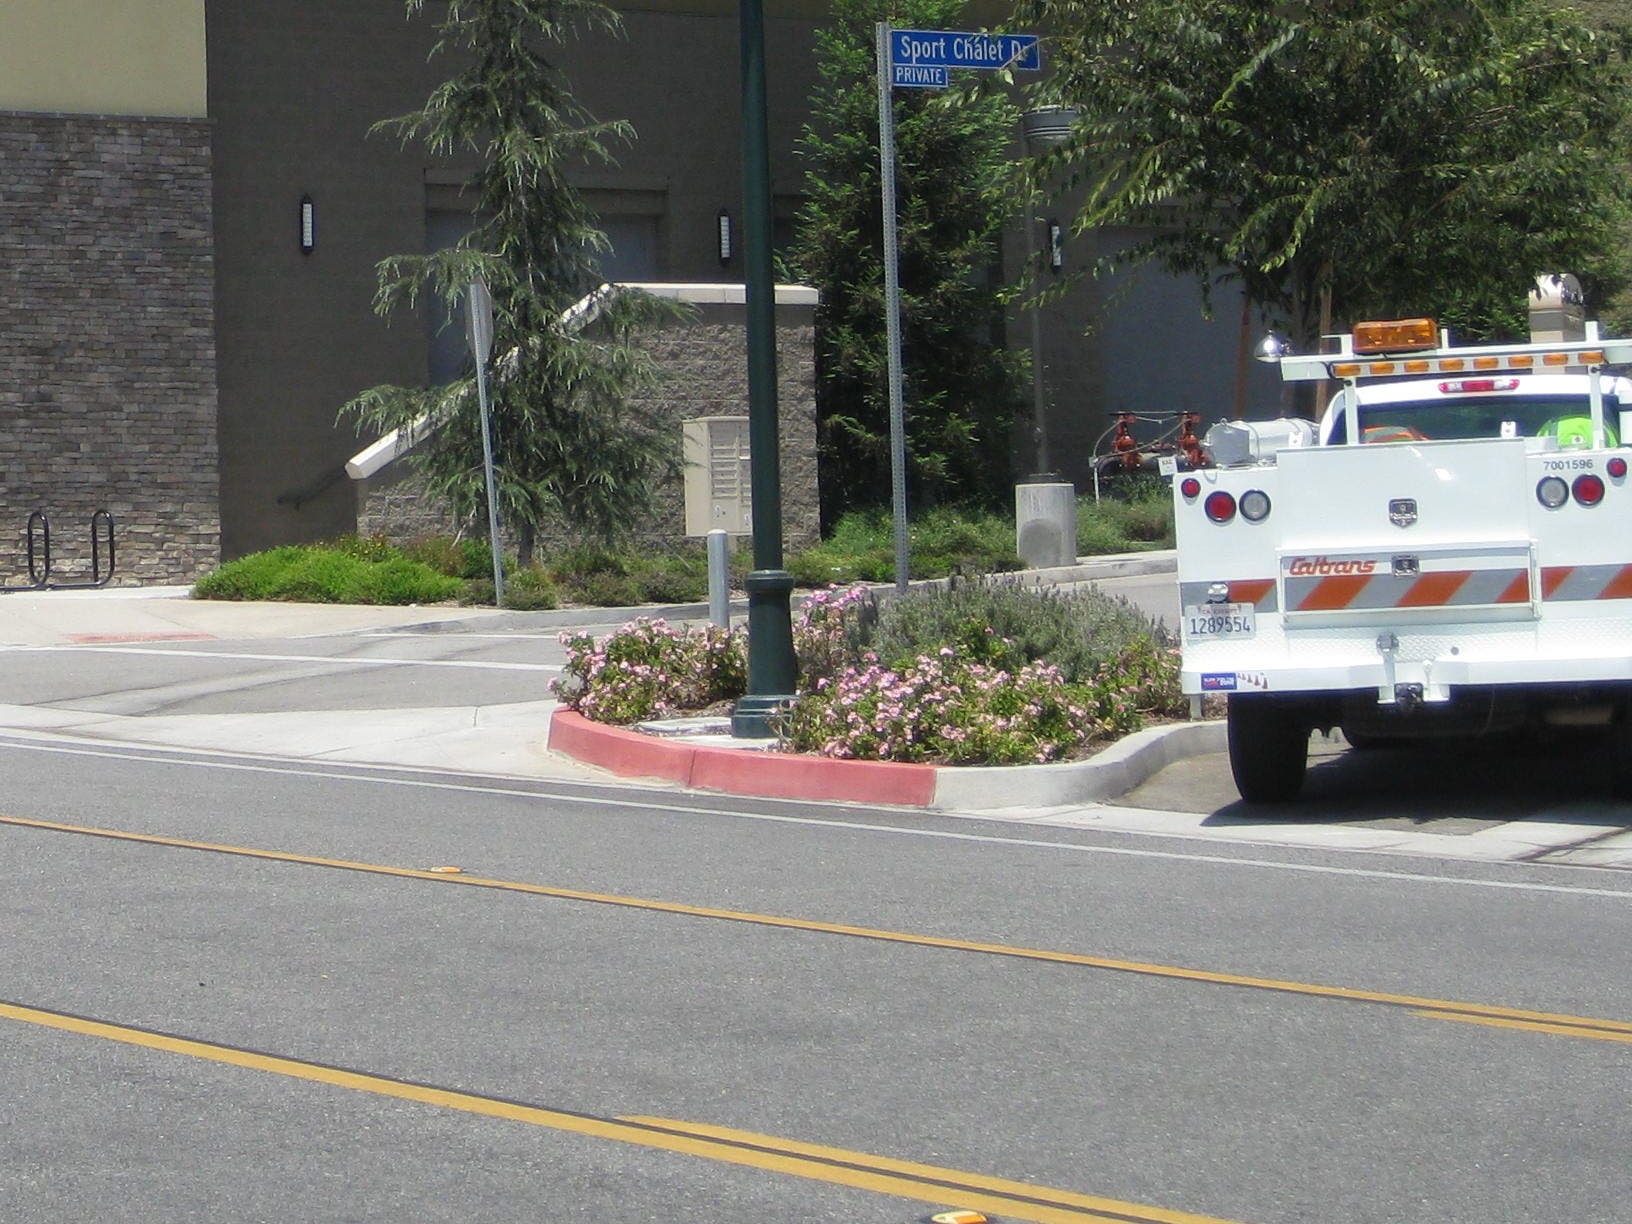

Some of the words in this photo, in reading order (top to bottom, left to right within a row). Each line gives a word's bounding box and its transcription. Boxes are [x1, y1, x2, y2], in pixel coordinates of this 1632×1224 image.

[900, 35, 947, 65] Sport
[953, 37, 1004, 62] Chalet
[896, 67, 943, 84] PRIVATE
[1543, 458, 1594, 471] 7001596
[1289, 555, 1377, 575] Caltrans
[1190, 616, 1251, 635] 1289554
